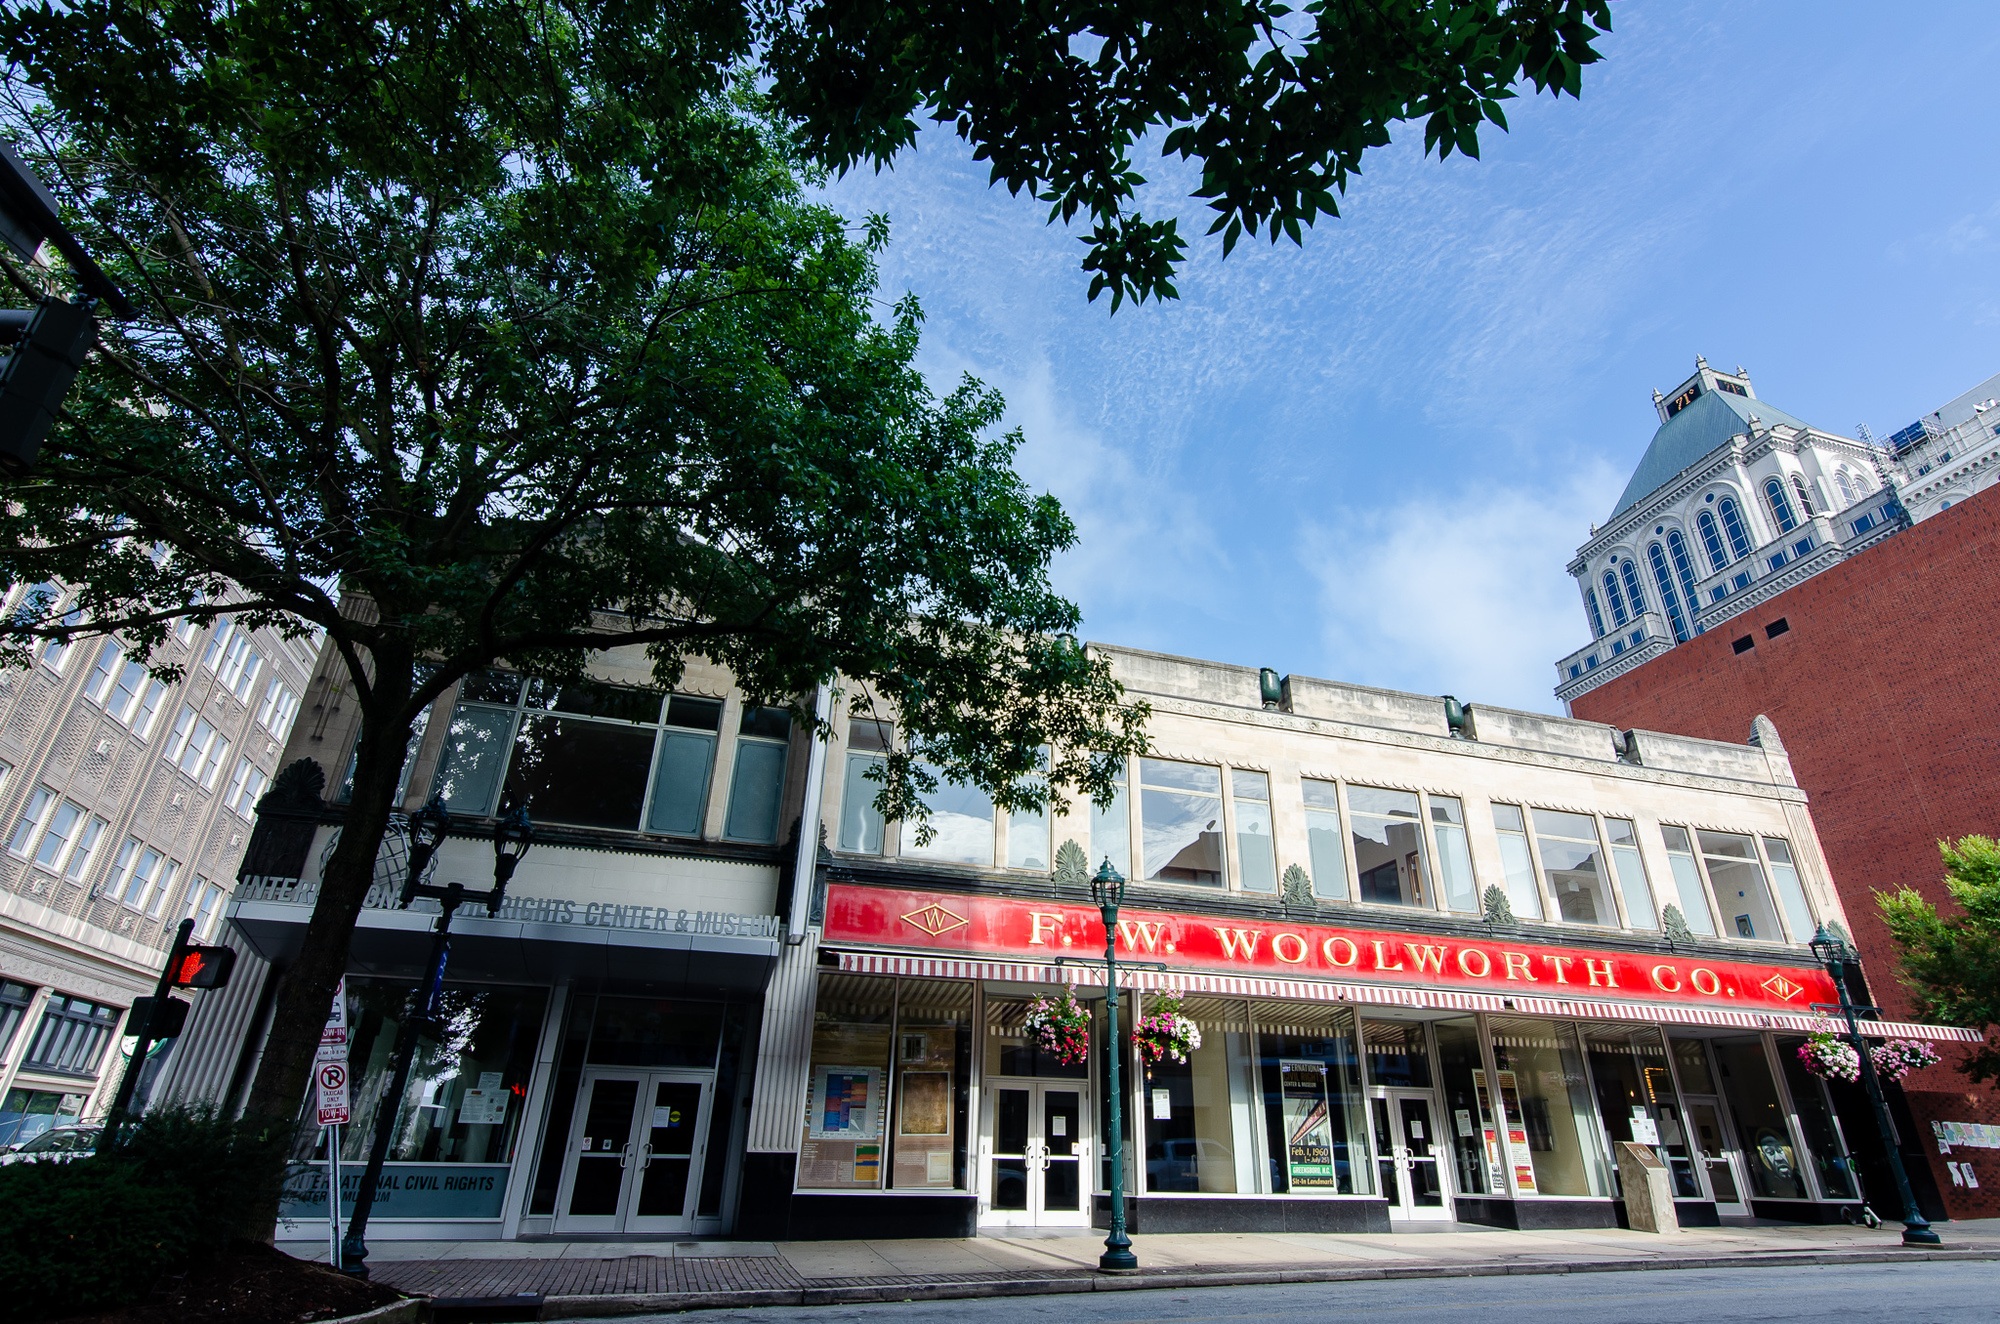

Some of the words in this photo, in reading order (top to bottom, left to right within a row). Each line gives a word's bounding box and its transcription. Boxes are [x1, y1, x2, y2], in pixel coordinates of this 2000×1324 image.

[237, 874, 415, 913] INTERONL
[496, 896, 576, 924] RIGHTS
[585, 902, 670, 931] CENTER
[674, 909, 690, 932] &
[694, 910, 781, 937] MUSEUM
[924, 908, 947, 931] W
[1028, 912, 1073, 946] F.
[1115, 919, 1177, 954] W.
[1213, 927, 1620, 988] WOOLWORTH
[1651, 964, 1736, 997] CO.
[1772, 977, 1790, 995] W
[323, 1028, 346, 1037] OW-IN
[320, 1107, 348, 1118] TOW-IN
[1291, 1147, 1306, 1156] Feb.
[1312, 1147, 1329, 1156] 1960
[405, 1175, 440, 1190] CIVIL
[444, 1176, 495, 1191] RIGHTS
[1307, 1177, 1333, 1186] Landmark
[342, 1191, 391, 1203] MUUM
